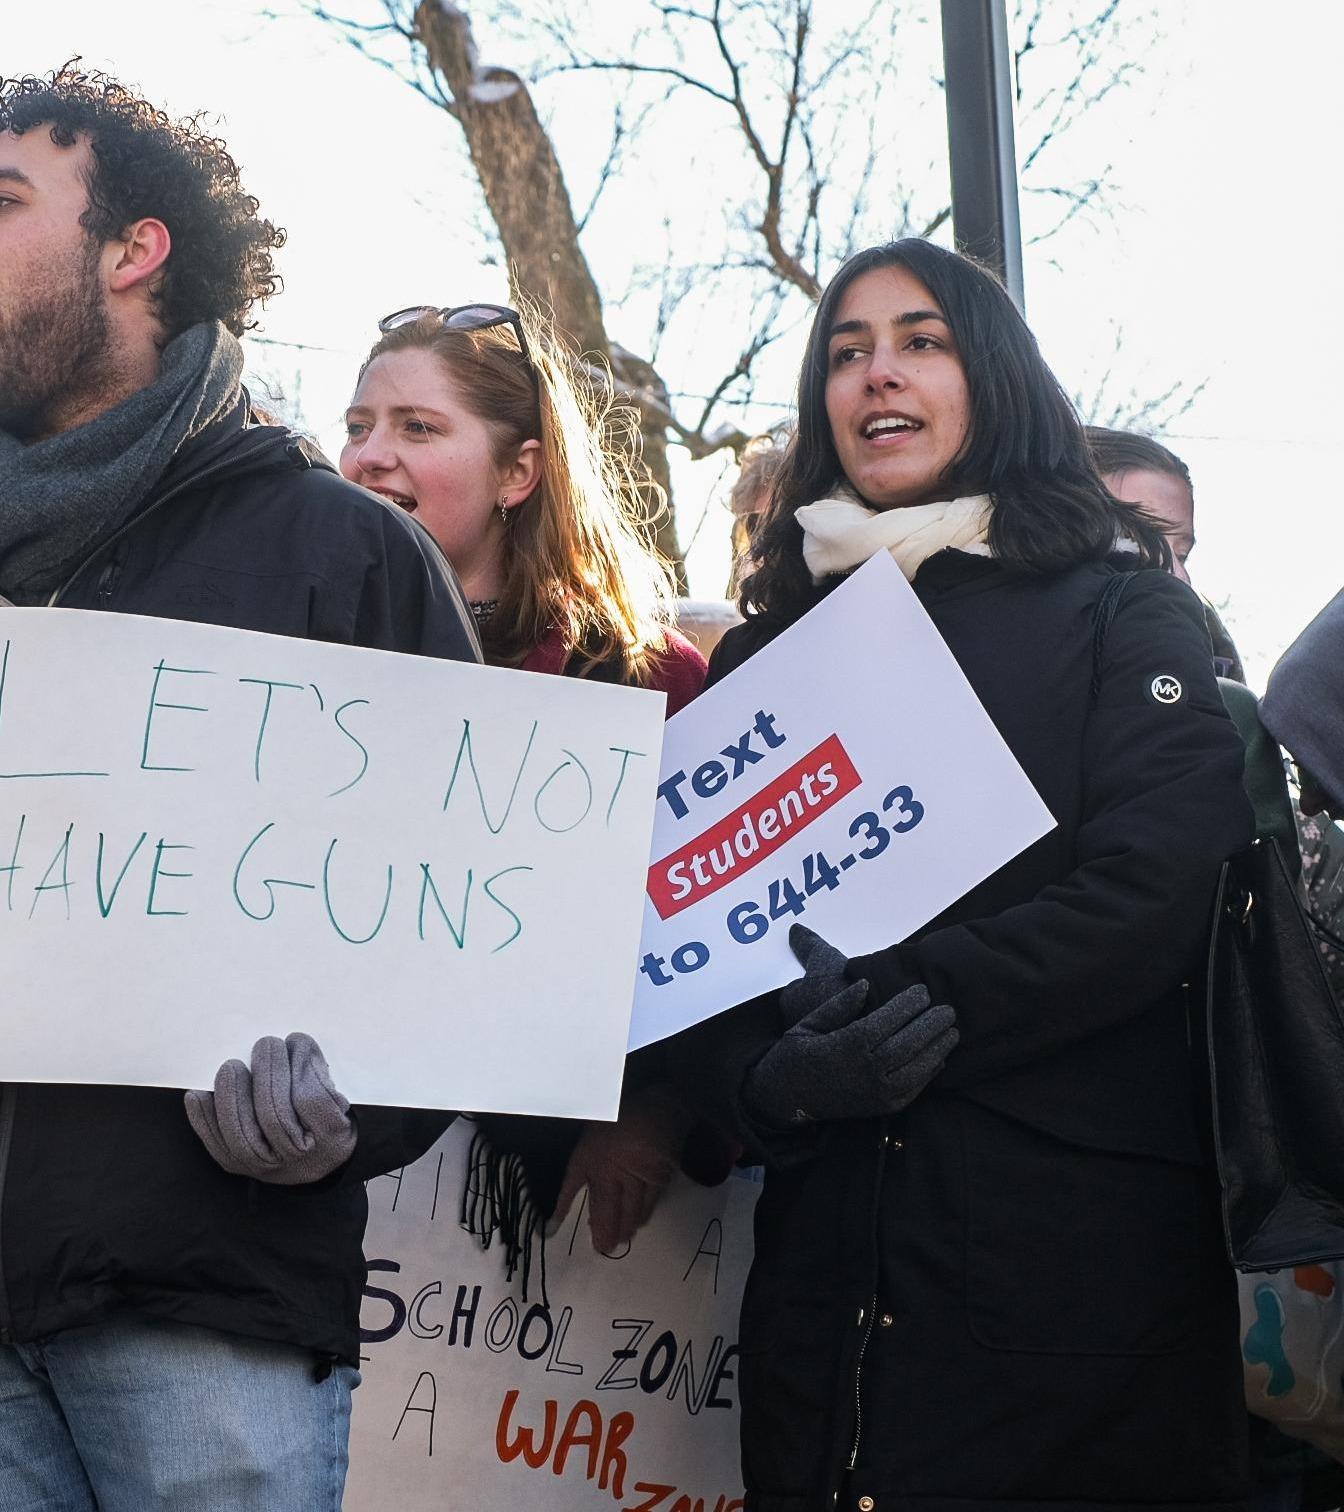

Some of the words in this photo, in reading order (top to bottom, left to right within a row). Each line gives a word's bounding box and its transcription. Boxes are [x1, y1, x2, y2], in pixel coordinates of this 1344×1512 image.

[1153, 678, 1180, 700] MK
[442, 718, 647, 834] NOT
[656, 709, 787, 821] Text
[232, 822, 534, 953] GUNS
[640, 941, 711, 987] to
[726, 784, 925, 945] 644-33
[666, 759, 839, 901] Students
[683, 1217, 724, 1295] A
[359, 1258, 584, 1376] SCHOOL
[595, 1318, 740, 1416] ZONE
[391, 1371, 437, 1457] A
[495, 1389, 635, 1500] WAR
